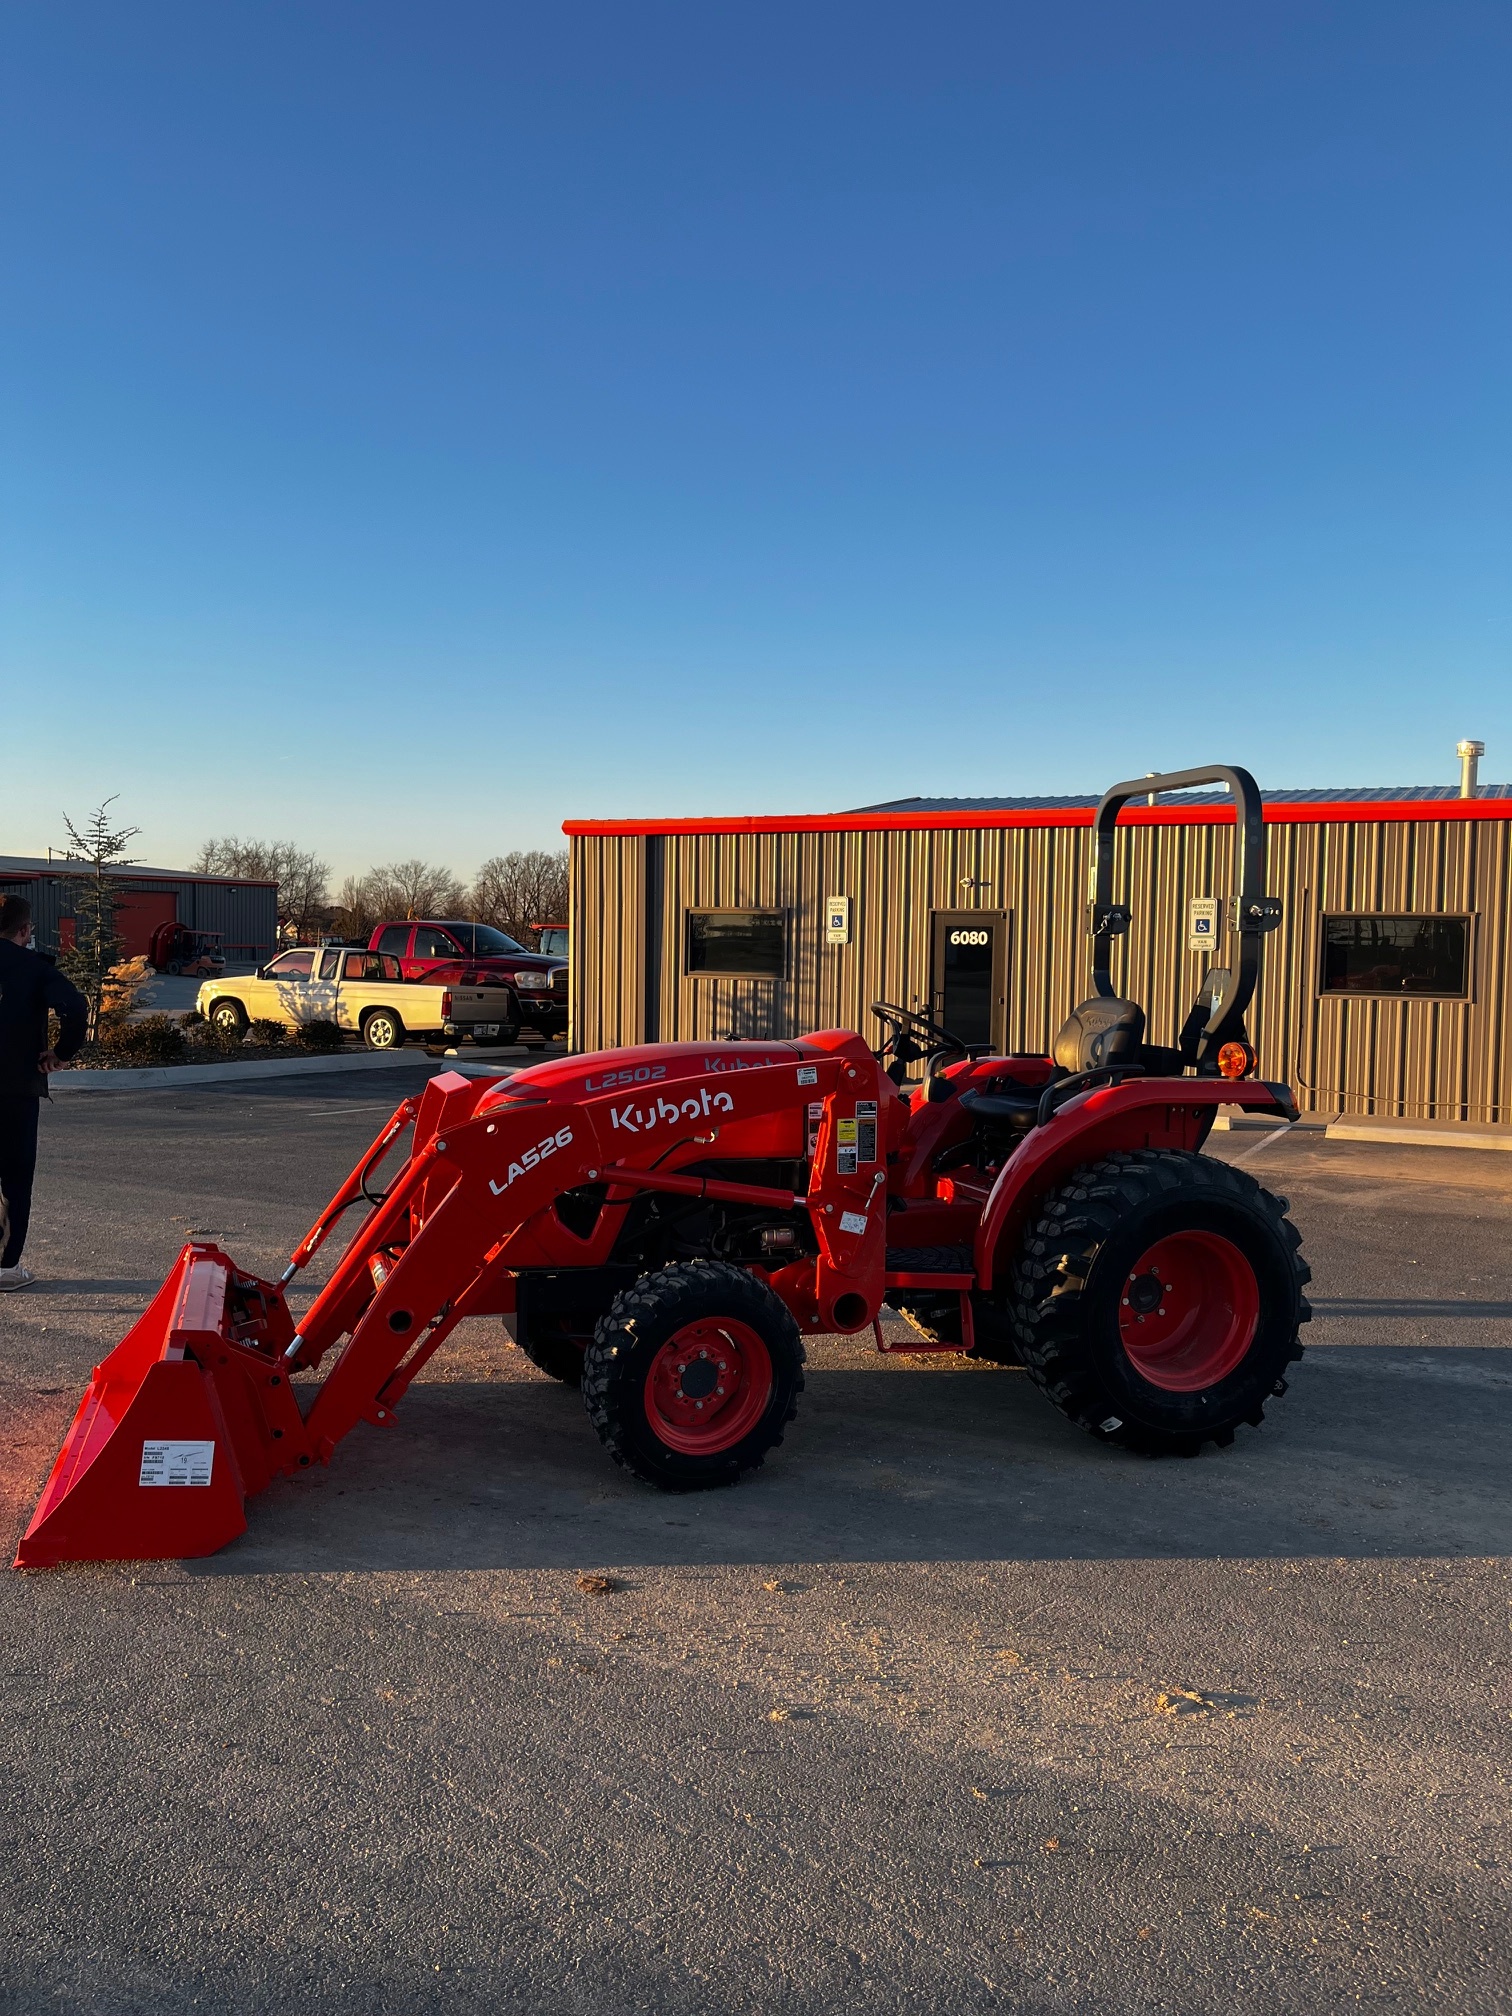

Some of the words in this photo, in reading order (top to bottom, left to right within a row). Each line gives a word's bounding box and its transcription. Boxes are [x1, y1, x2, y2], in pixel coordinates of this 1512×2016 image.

[950, 931, 988, 945] 6080
[585, 1065, 667, 1092] L2502
[610, 1088, 734, 1133] Kubota
[488, 1125, 574, 1196] LA526
